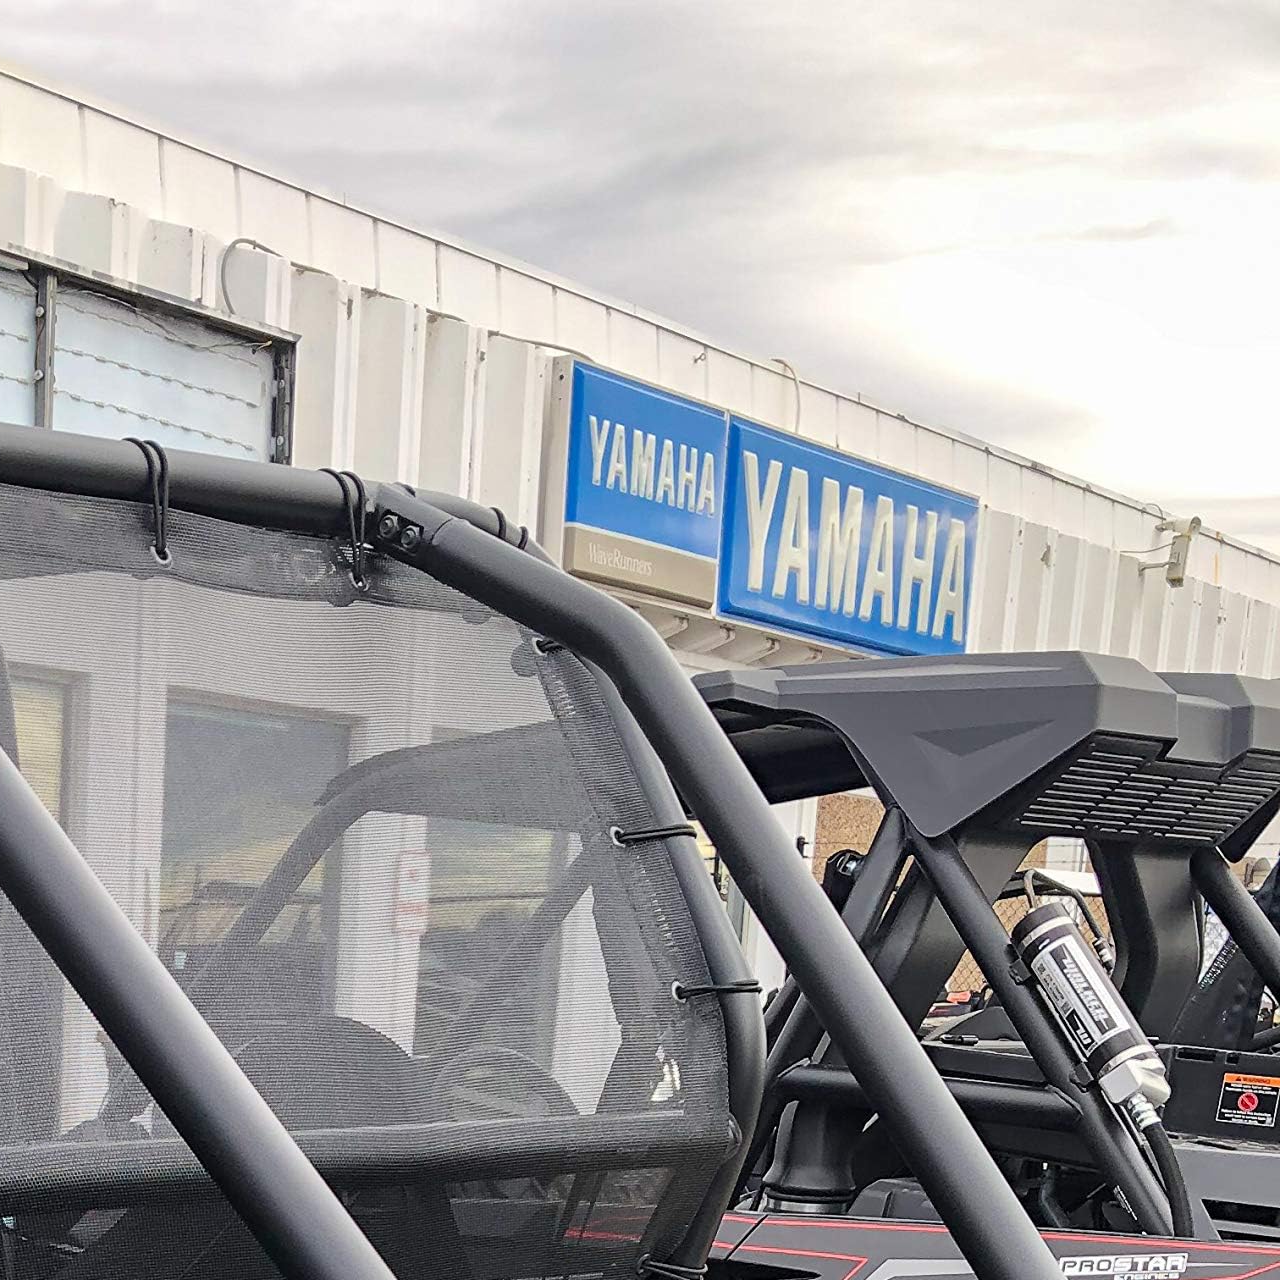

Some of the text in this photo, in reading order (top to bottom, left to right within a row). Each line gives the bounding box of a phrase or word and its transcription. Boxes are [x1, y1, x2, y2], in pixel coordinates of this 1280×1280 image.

[588, 414, 716, 519] YAMAHA
[742, 449, 966, 645] YAMAHA
[1061, 1255, 1186, 1274] PROSTAR
